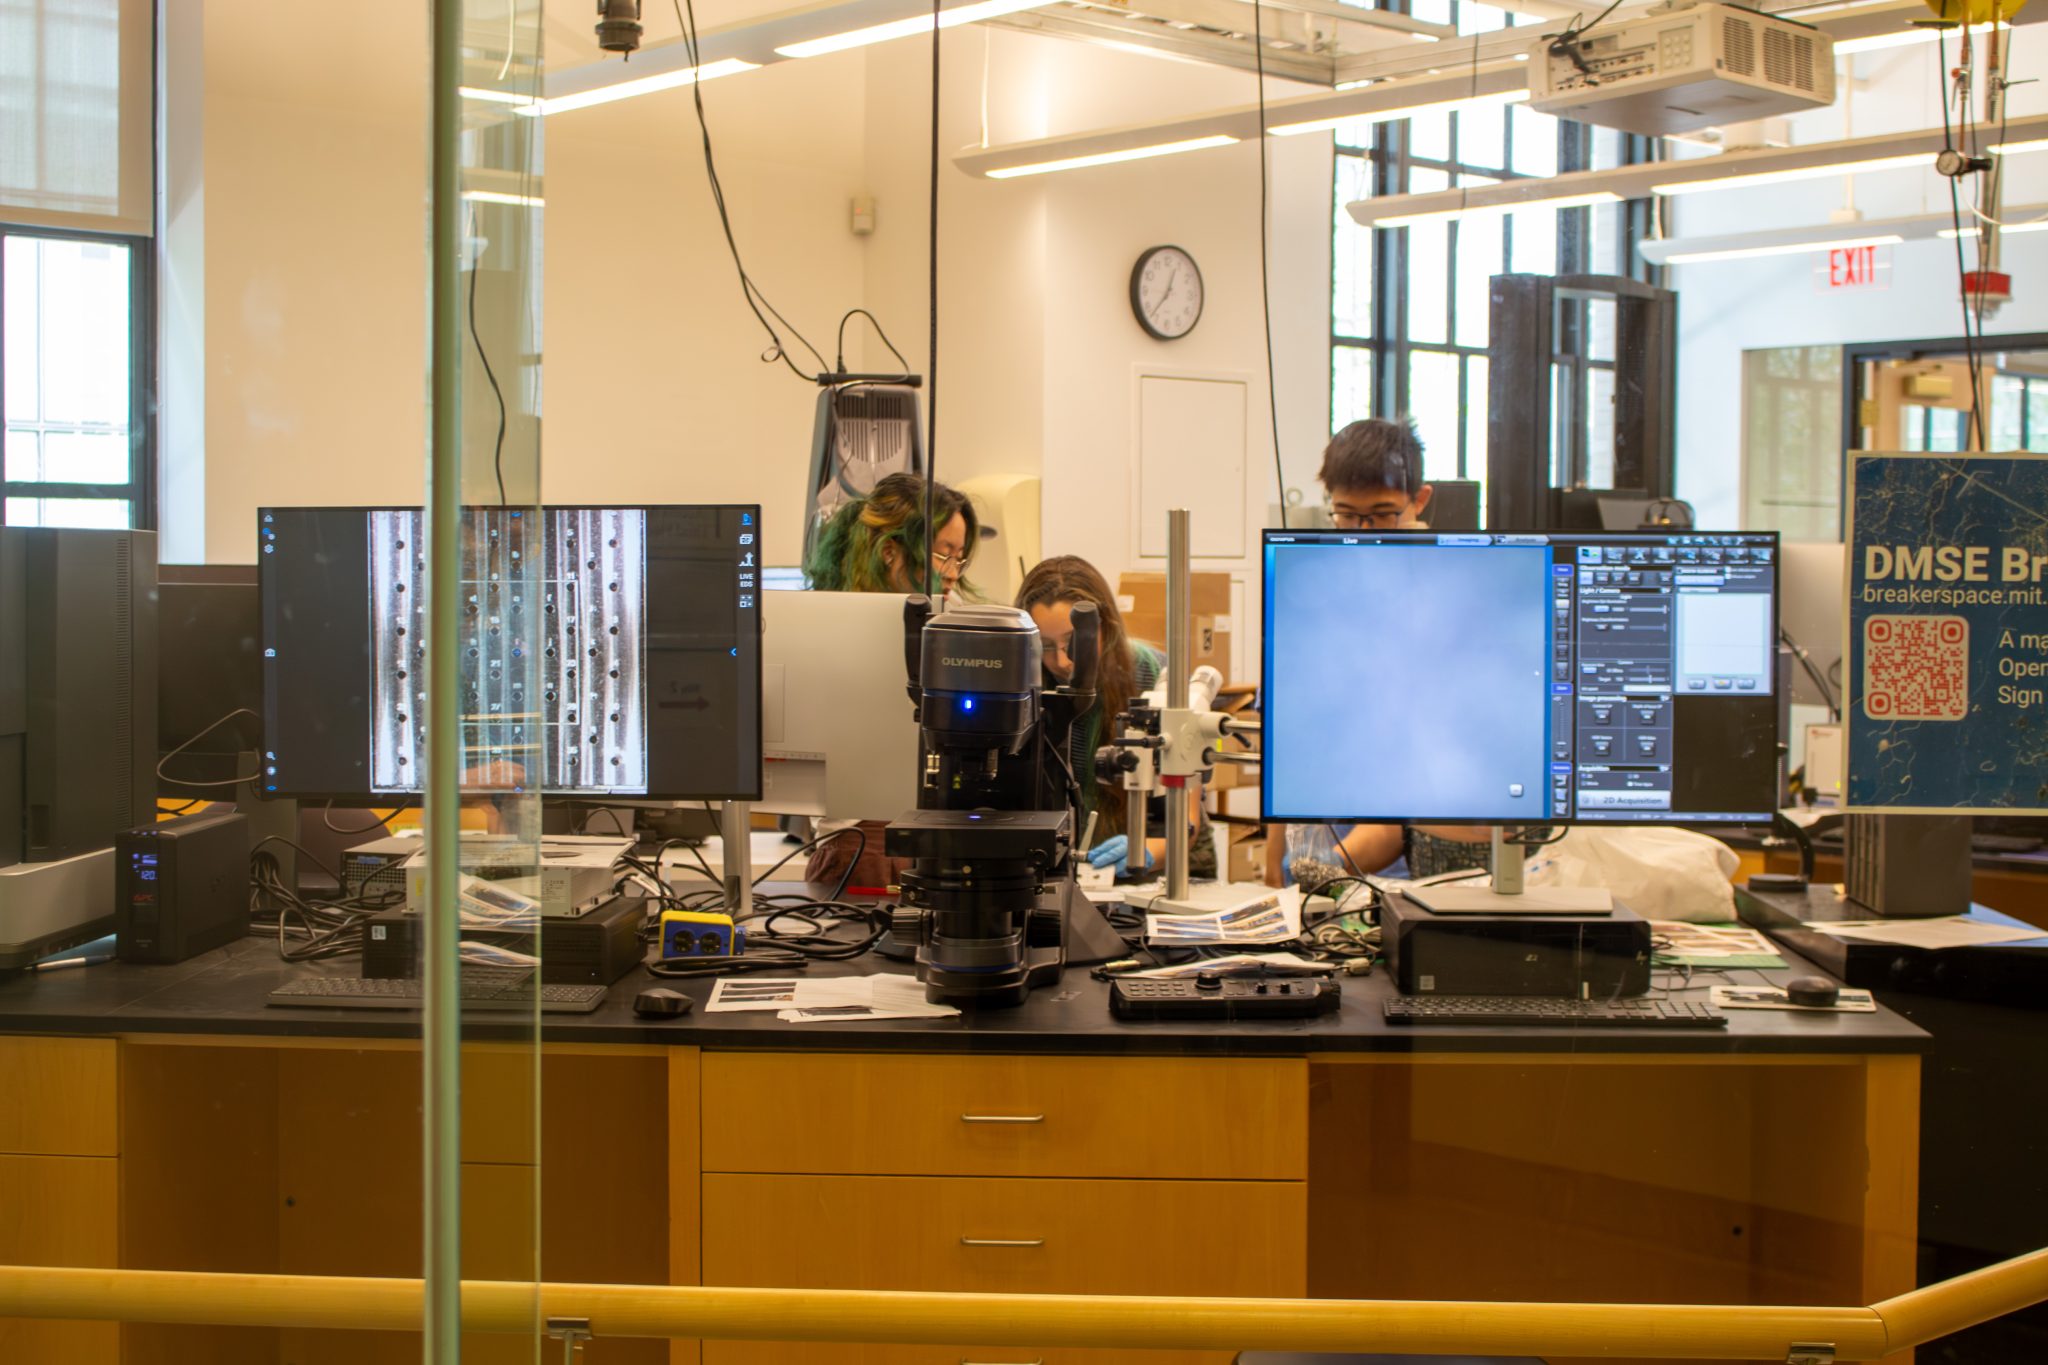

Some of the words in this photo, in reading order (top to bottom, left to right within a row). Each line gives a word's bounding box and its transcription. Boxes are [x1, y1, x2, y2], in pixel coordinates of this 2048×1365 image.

[1830, 246, 1877, 287] EXIT
[1865, 545, 1990, 582] DMSE
[2001, 547, 2048, 583] Br
[1863, 583, 2048, 609] breakerspace.mit.
[1998, 629, 2015, 649] A
[941, 656, 1003, 669] OLYMPUS
[1998, 684, 2043, 709] Sign
[1617, 796, 1664, 806] Acquisition
